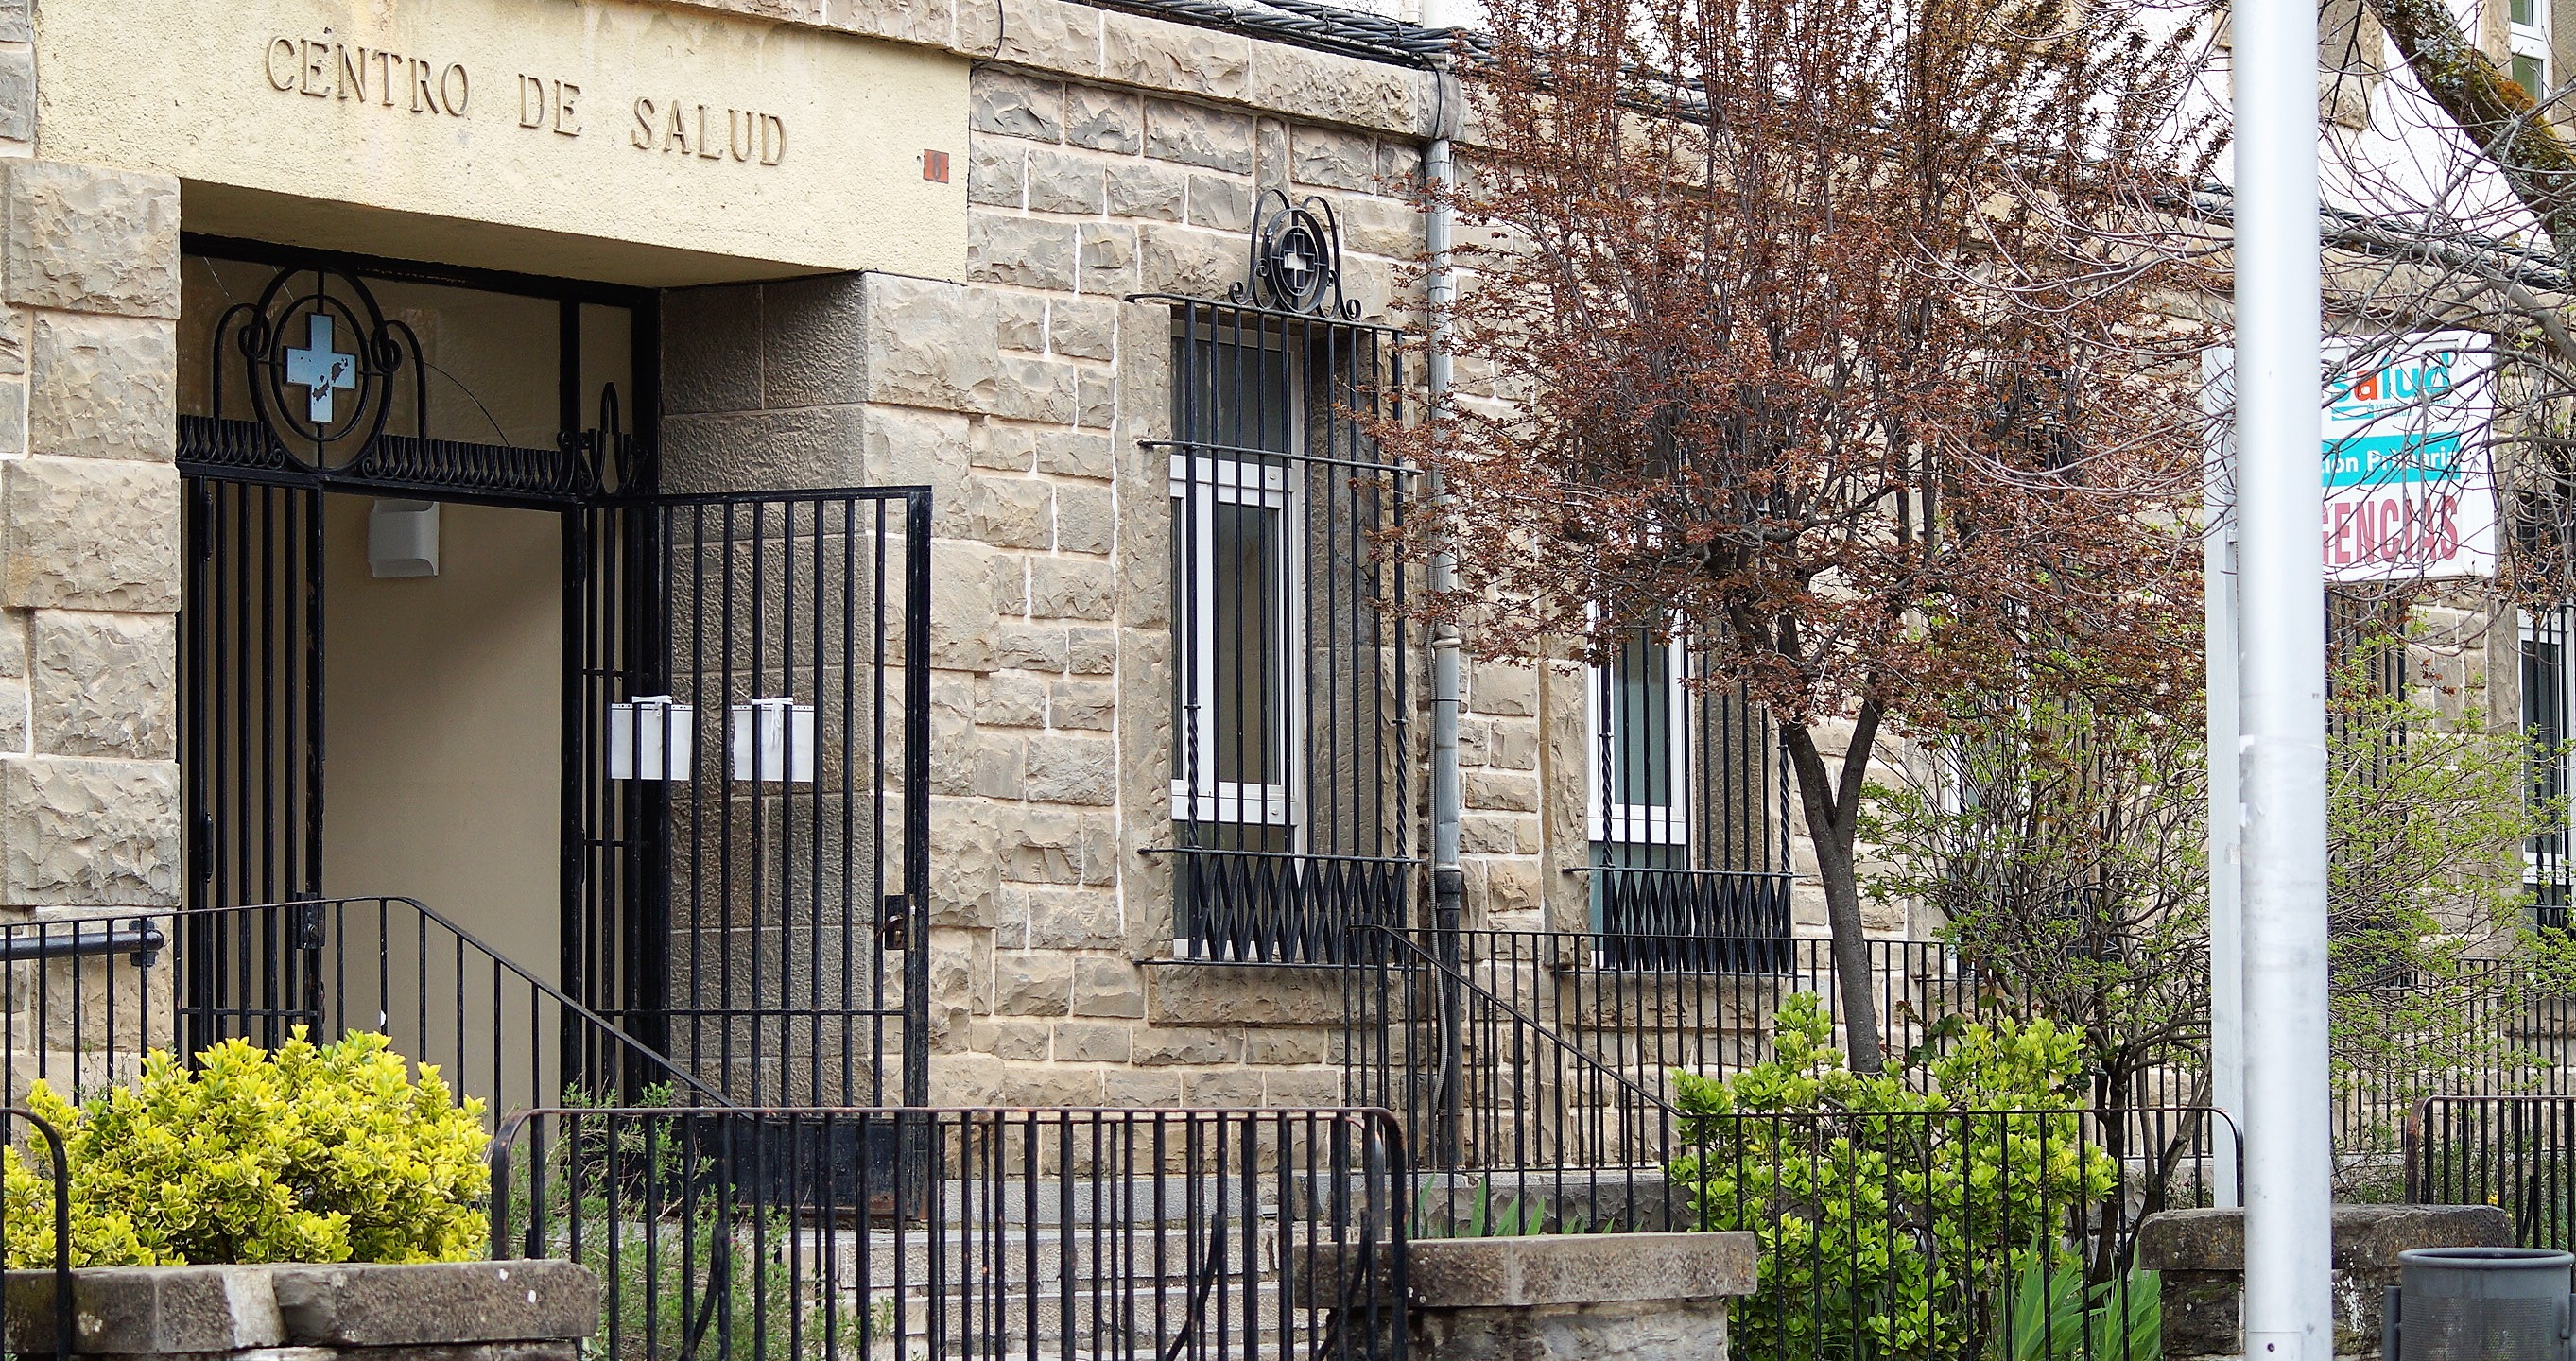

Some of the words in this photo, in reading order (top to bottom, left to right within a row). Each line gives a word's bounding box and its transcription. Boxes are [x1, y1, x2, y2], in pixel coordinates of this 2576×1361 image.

[266, 36, 470, 116] CENTRO
[519, 73, 582, 136] DE
[631, 96, 787, 166] SALUD
[2331, 352, 2450, 403] salud
